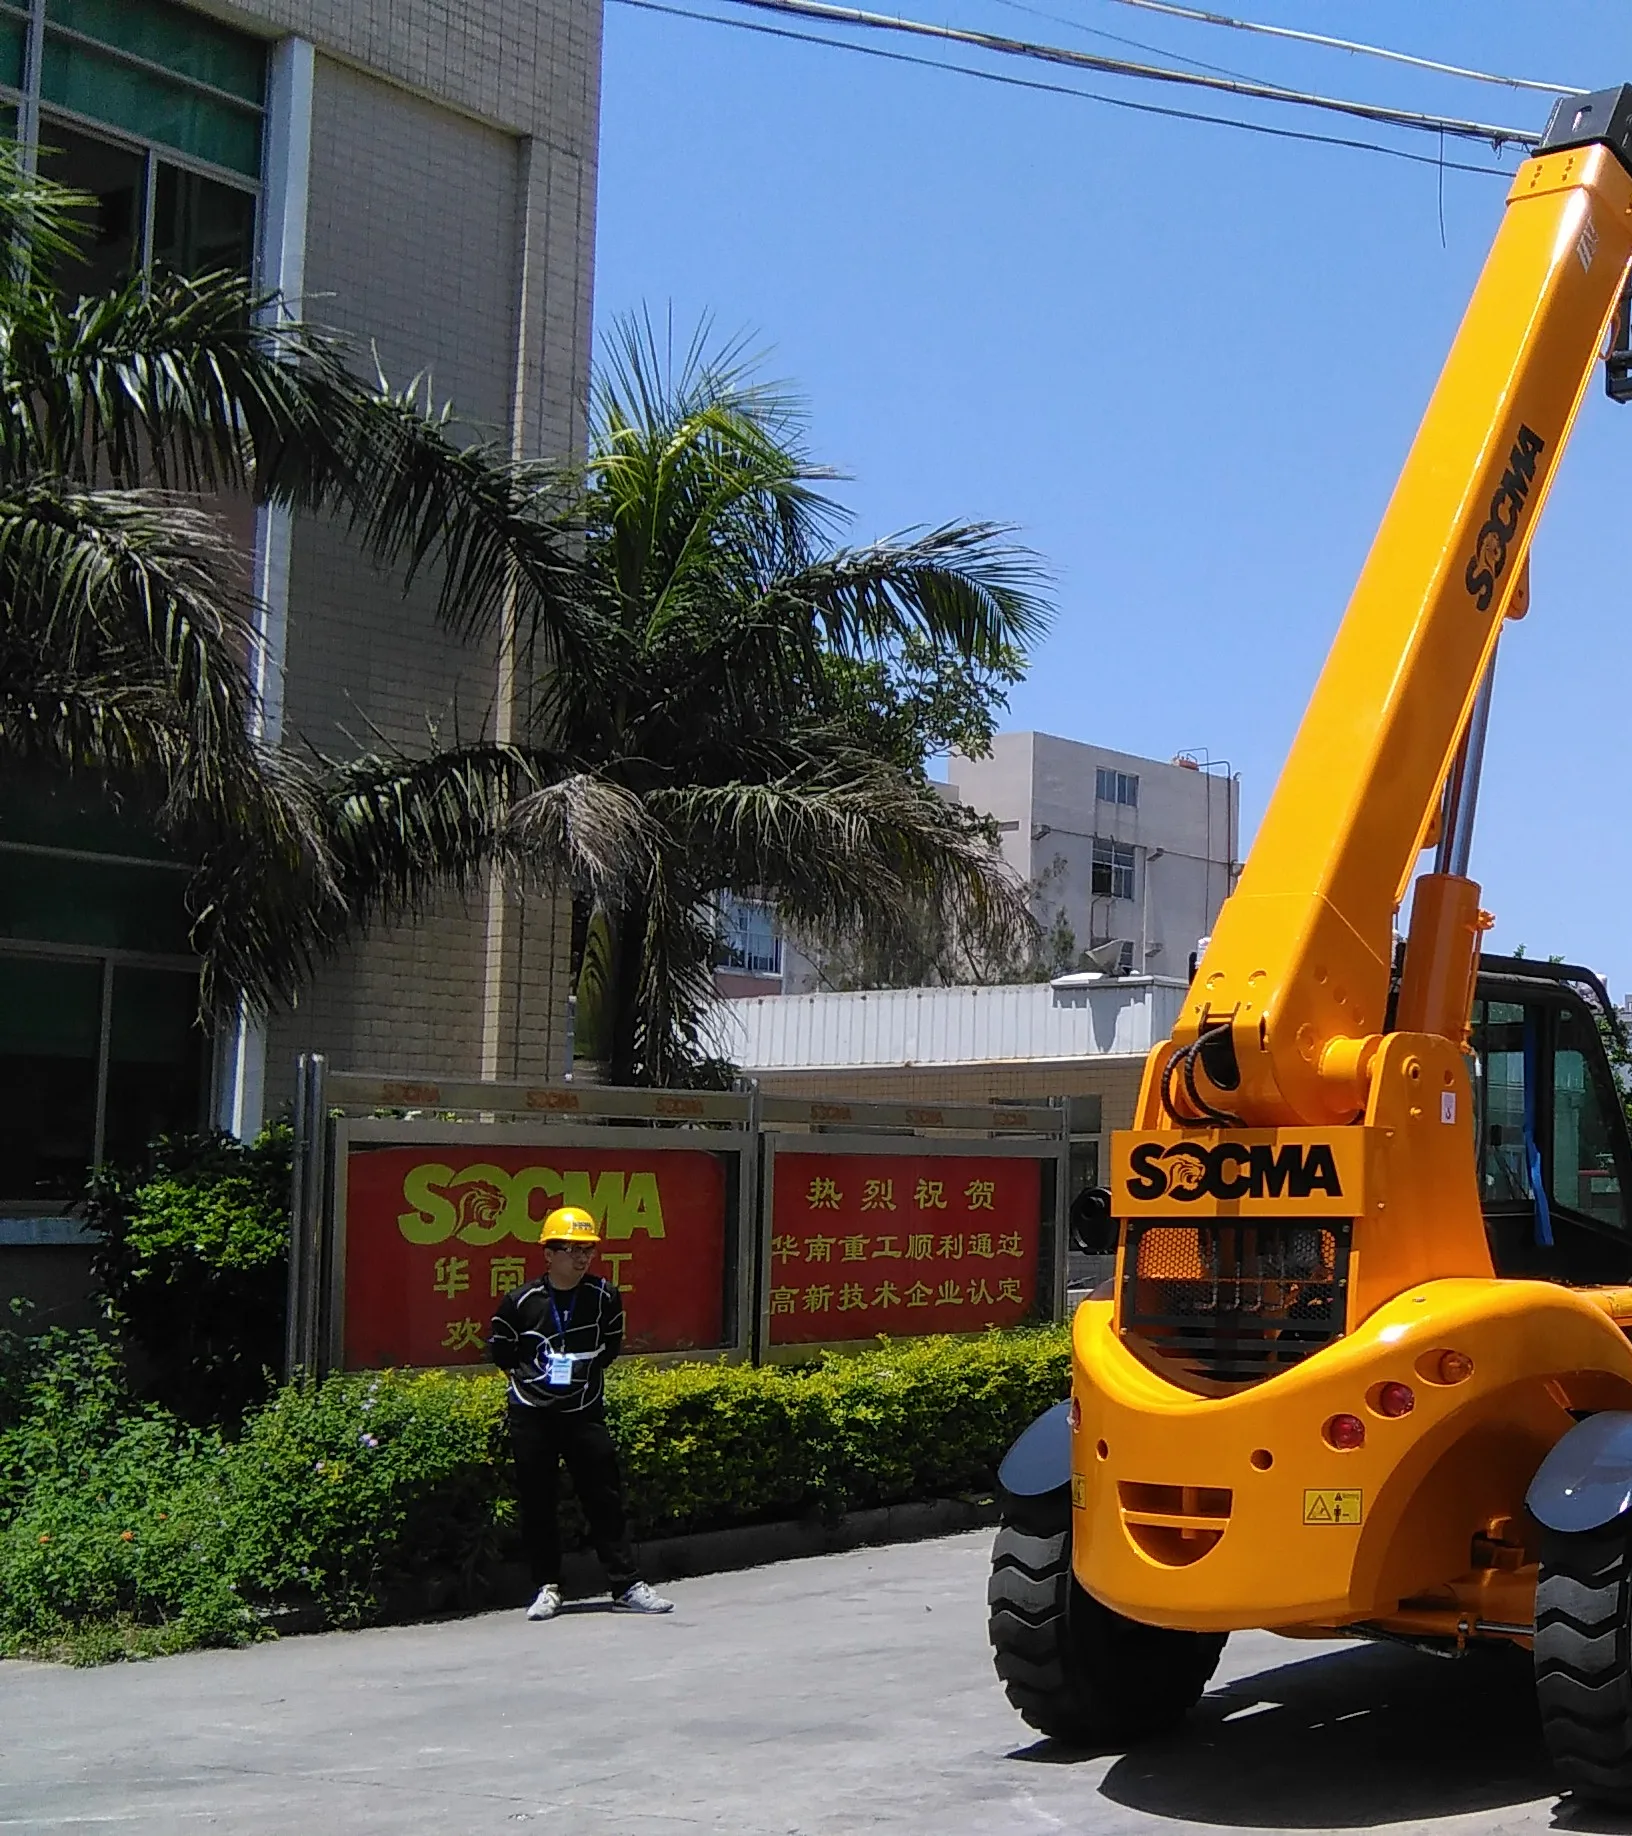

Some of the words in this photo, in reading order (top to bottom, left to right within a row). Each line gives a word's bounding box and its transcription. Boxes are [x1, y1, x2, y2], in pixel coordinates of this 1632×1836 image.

[1465, 423, 1545, 611] SOCMA
[805, 1177, 995, 1211] 热烈祝贺
[1126, 1142, 1343, 1201] SOCMA
[397, 1163, 666, 1246] SOCMA
[772, 1230, 1024, 1264] 华南重工顺利通过
[433, 1253, 633, 1299] 华南工
[769, 1278, 1023, 1315] 高新技术企业认定
